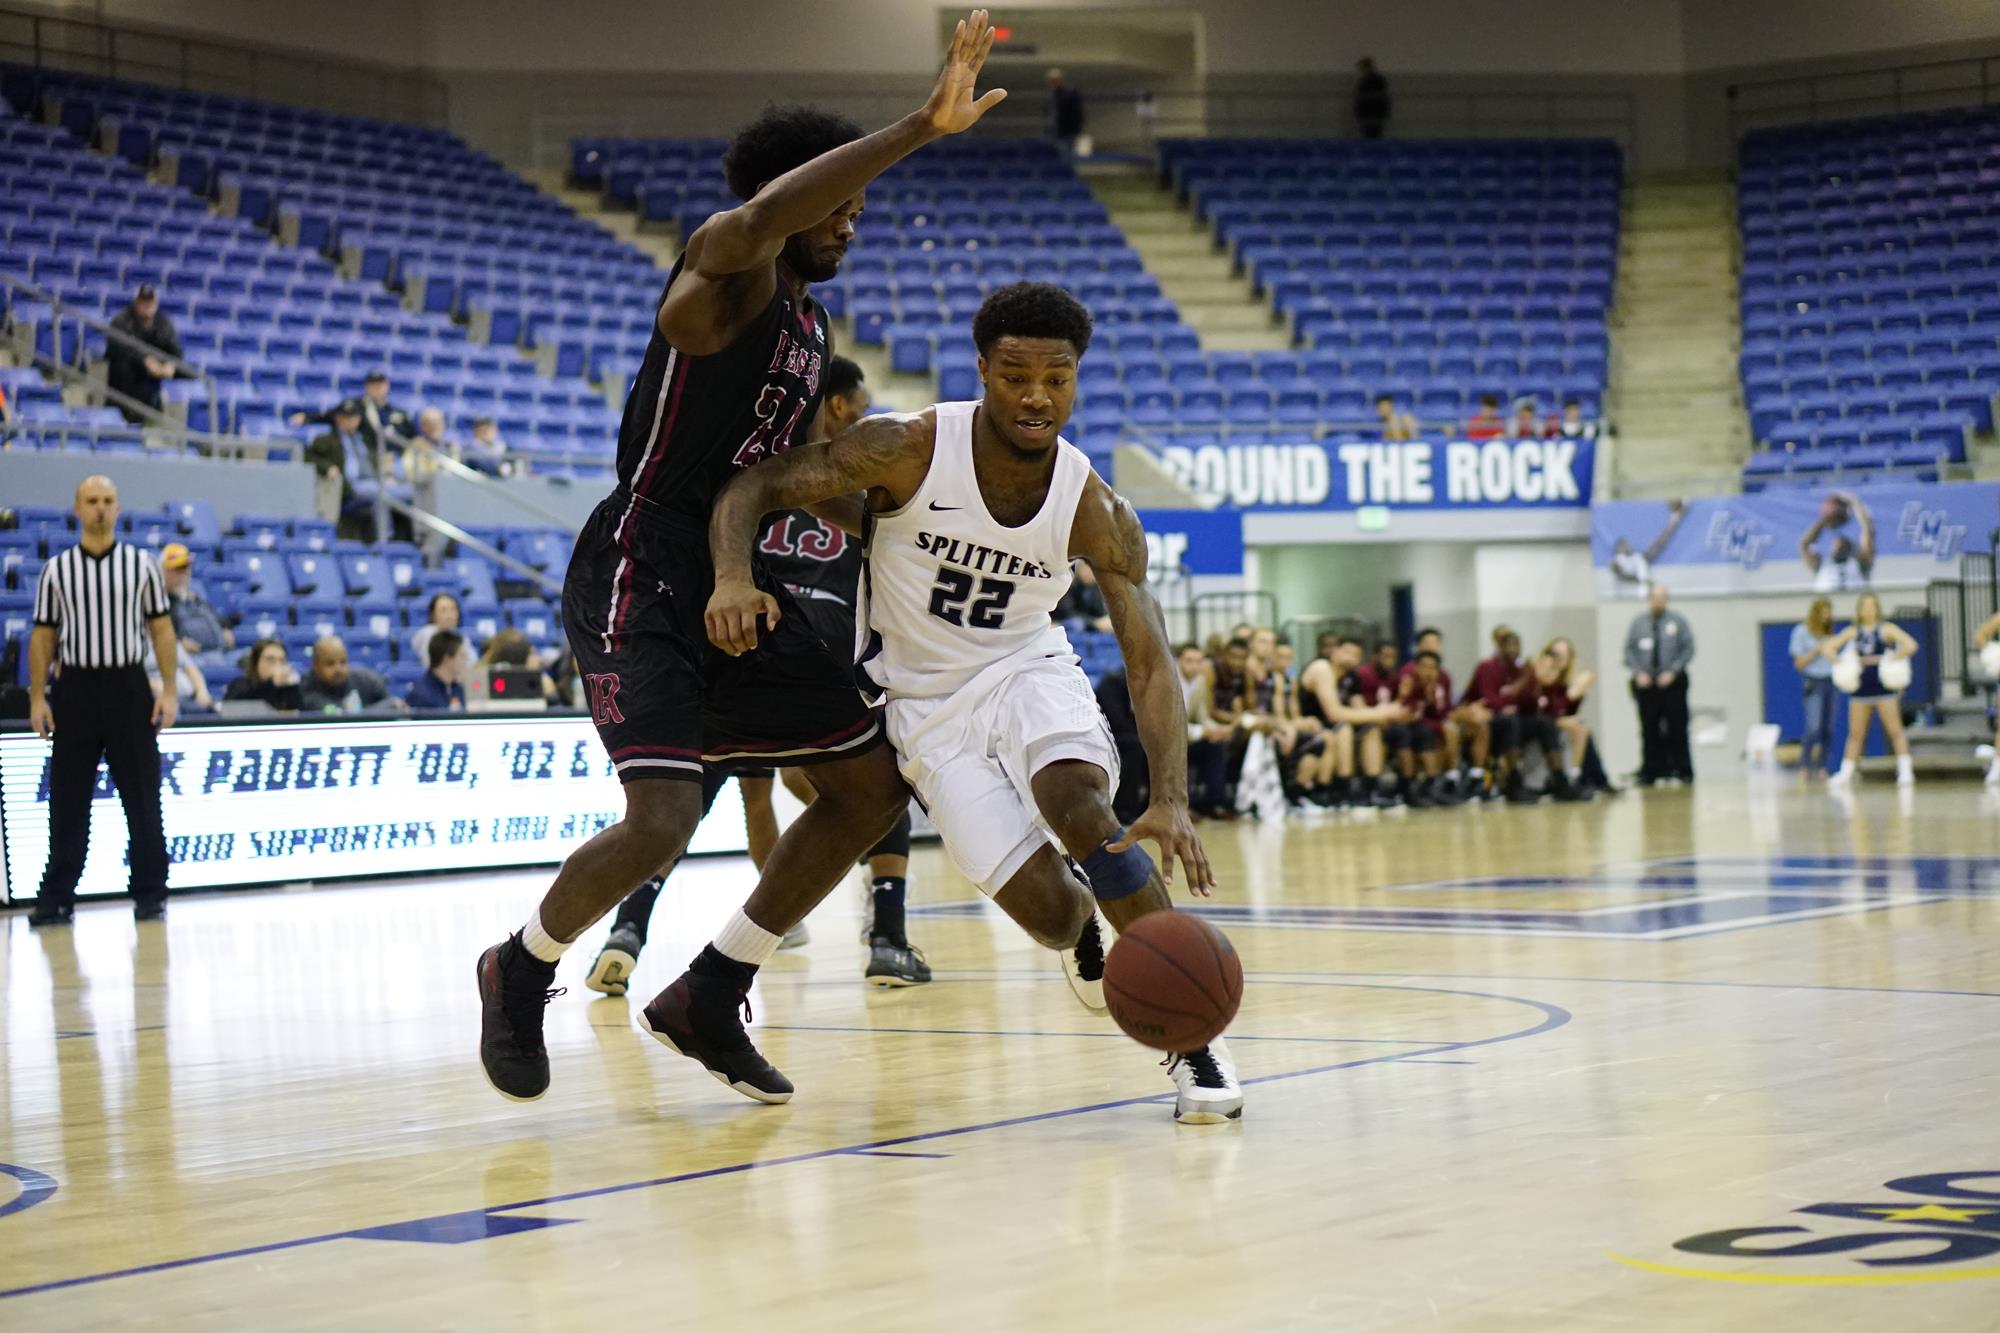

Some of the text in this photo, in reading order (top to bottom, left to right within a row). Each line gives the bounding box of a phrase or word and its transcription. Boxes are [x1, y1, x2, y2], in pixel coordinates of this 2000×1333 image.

[1338, 441, 1434, 504] THE
[1445, 438, 1580, 501] ROCK
[914, 531, 1052, 579] SPLITTERS
[927, 562, 1017, 630] 22
